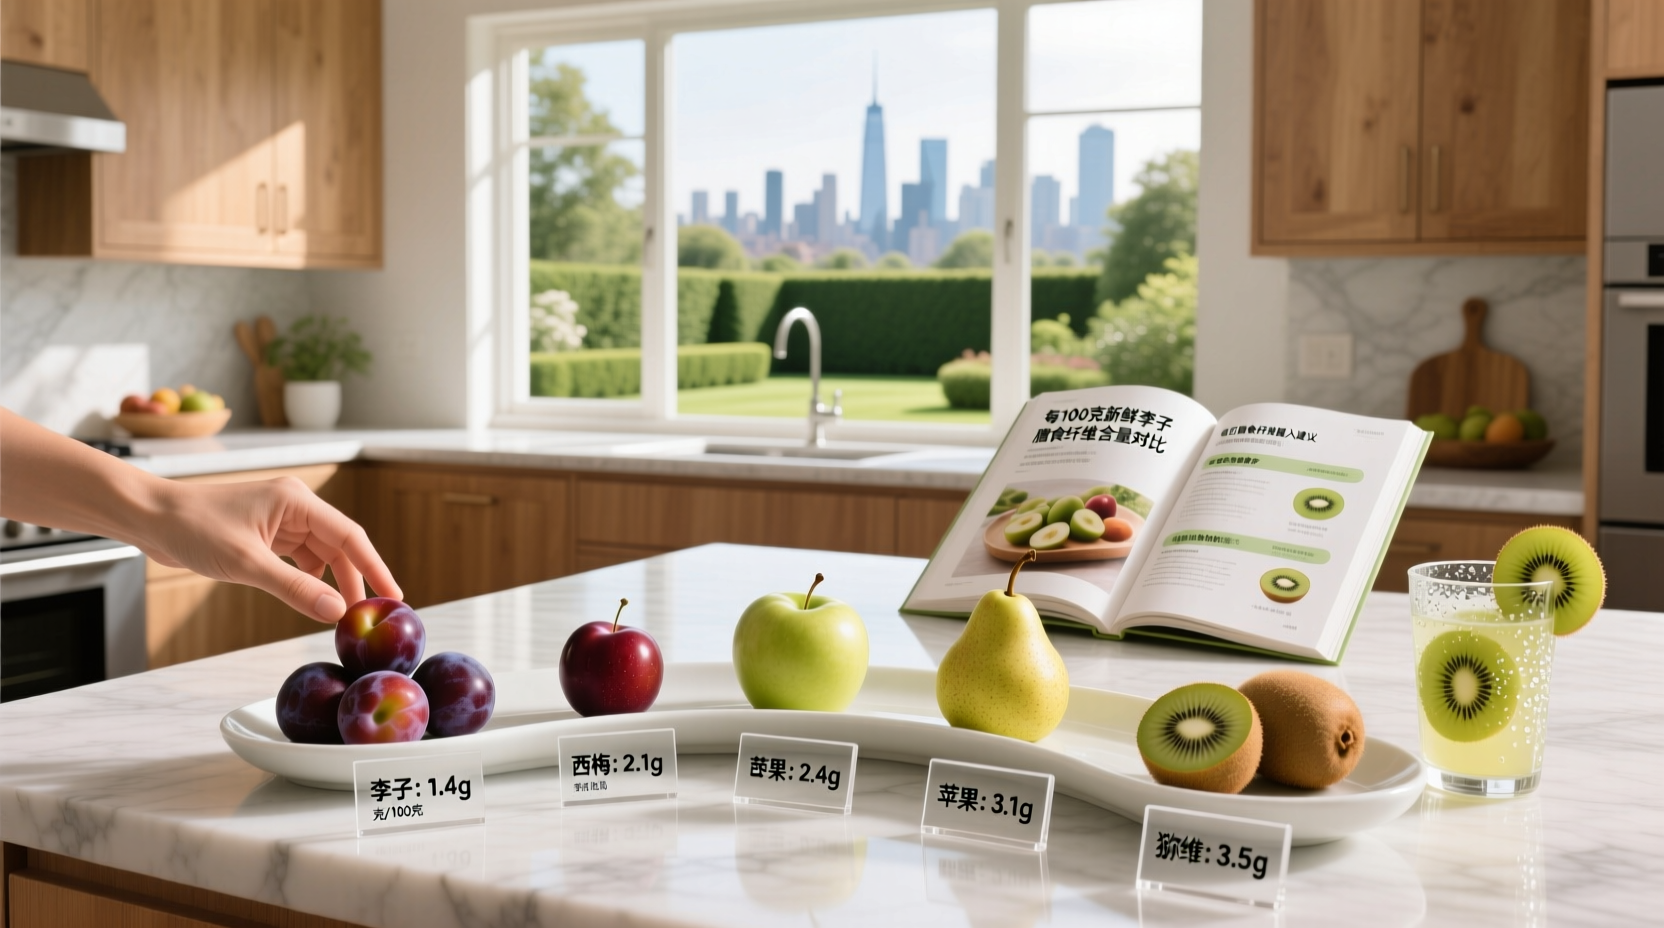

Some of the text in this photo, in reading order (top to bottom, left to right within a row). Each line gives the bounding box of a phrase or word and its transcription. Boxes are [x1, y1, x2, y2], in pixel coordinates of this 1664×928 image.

[622, 753, 663, 777] 2.1g
[798, 762, 841, 791] 2.4g
[370, 775, 471, 802] 李子: 1.4g
[990, 792, 1034, 825] 3.1g
[1216, 843, 1269, 880] 3.5g
